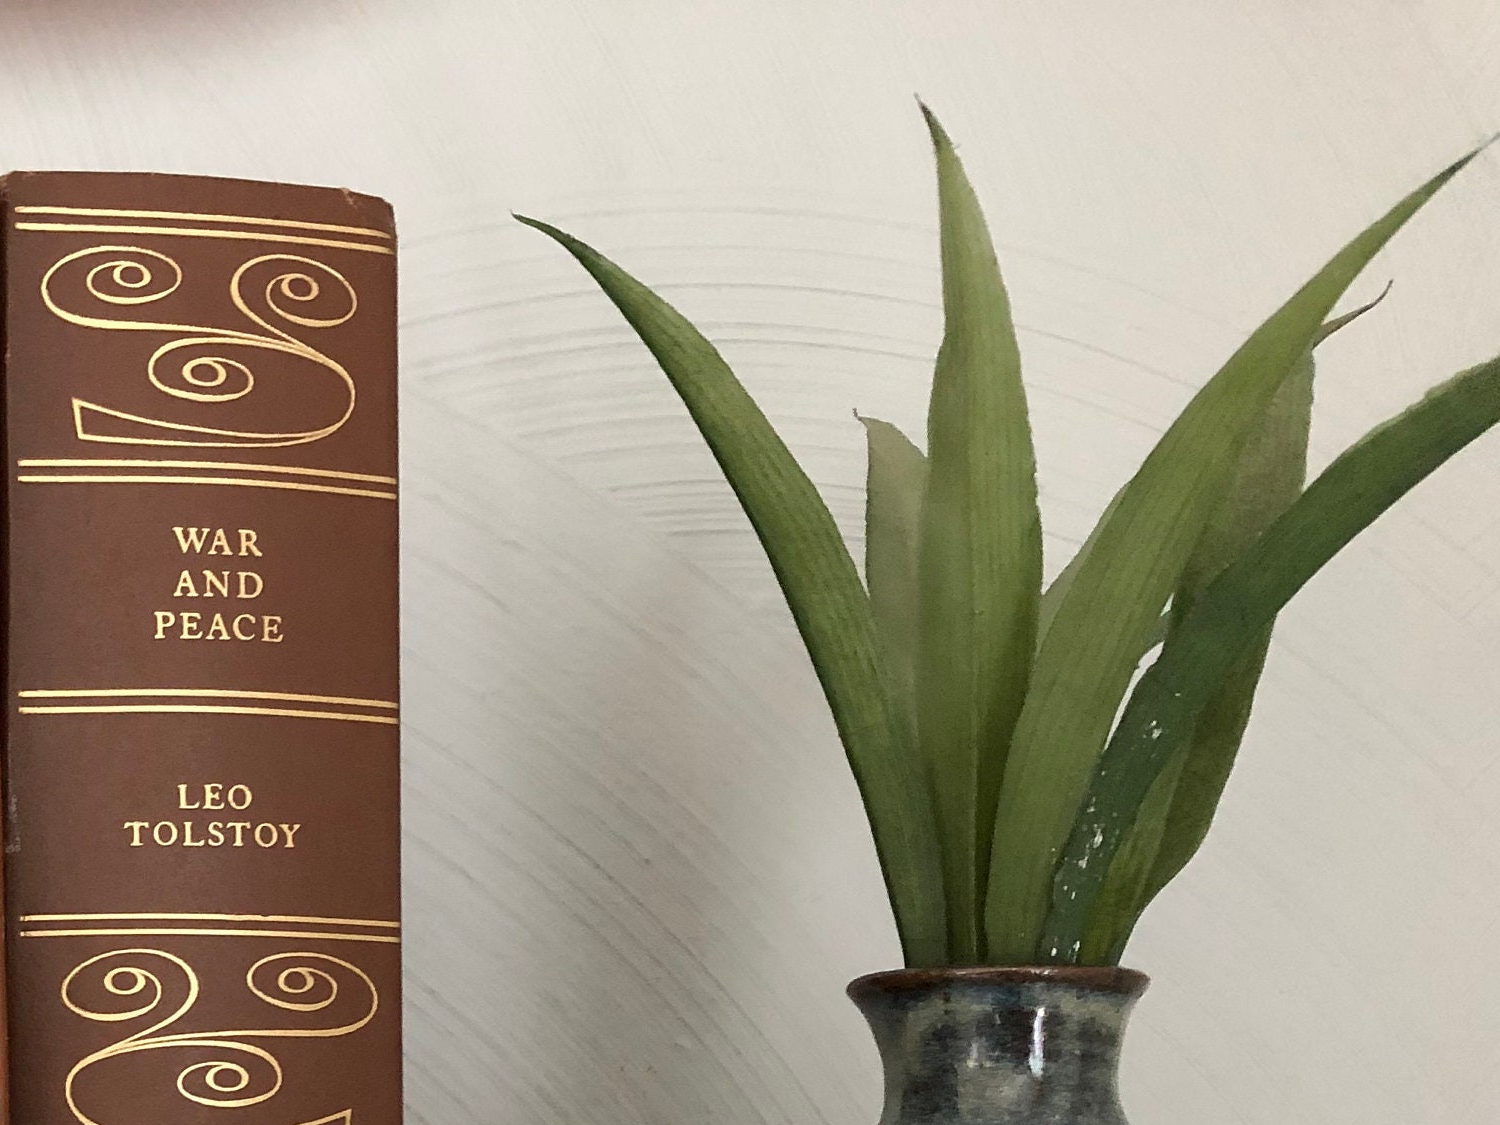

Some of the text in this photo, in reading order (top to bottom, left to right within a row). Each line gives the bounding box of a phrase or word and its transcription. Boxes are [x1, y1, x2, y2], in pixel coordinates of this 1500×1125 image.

[172, 526, 263, 557] WAR
[173, 569, 264, 600] AND
[153, 611, 284, 643] PEACE
[177, 783, 253, 811] LEO
[123, 820, 301, 848] TOLSTOY
